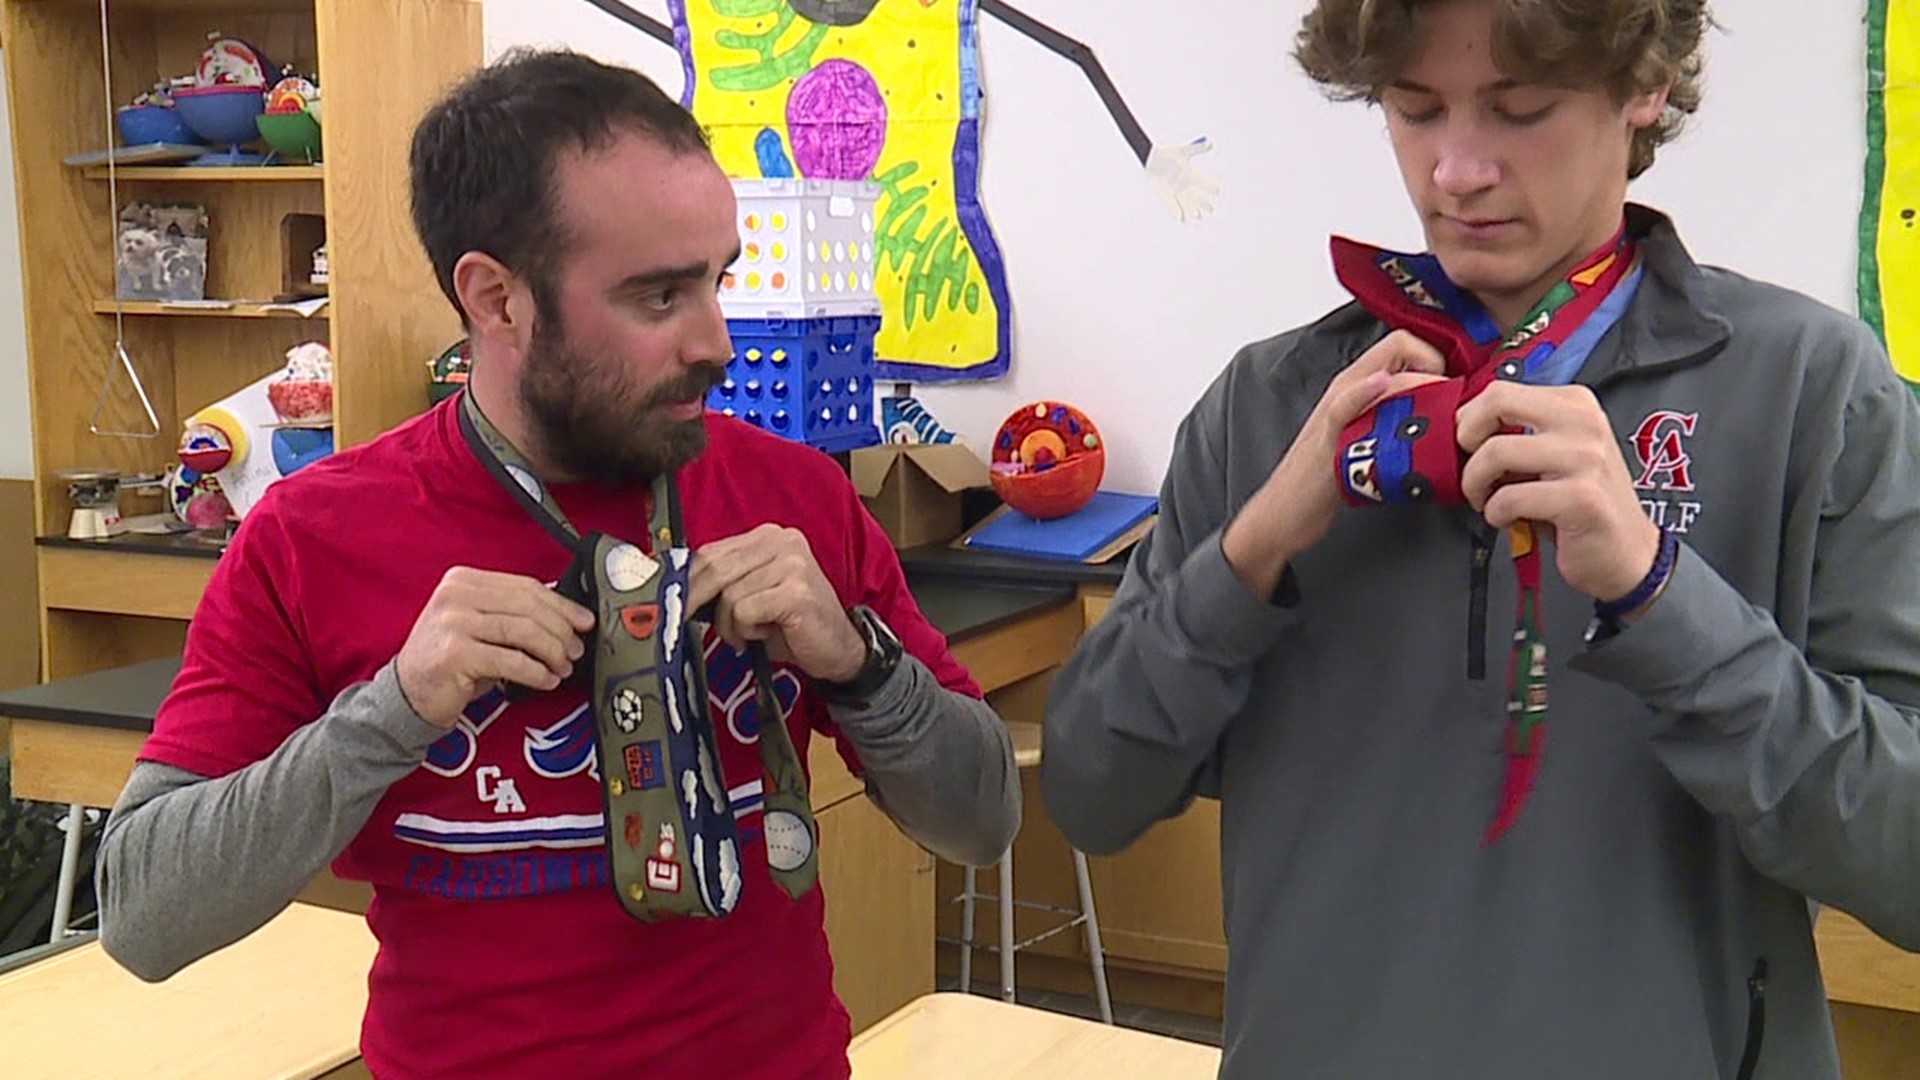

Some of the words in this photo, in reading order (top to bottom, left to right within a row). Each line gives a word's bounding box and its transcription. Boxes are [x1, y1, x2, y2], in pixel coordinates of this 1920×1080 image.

[1638, 499, 1702, 533] OLF
[475, 764, 527, 814] CA
[402, 853, 606, 901] CARBOND
